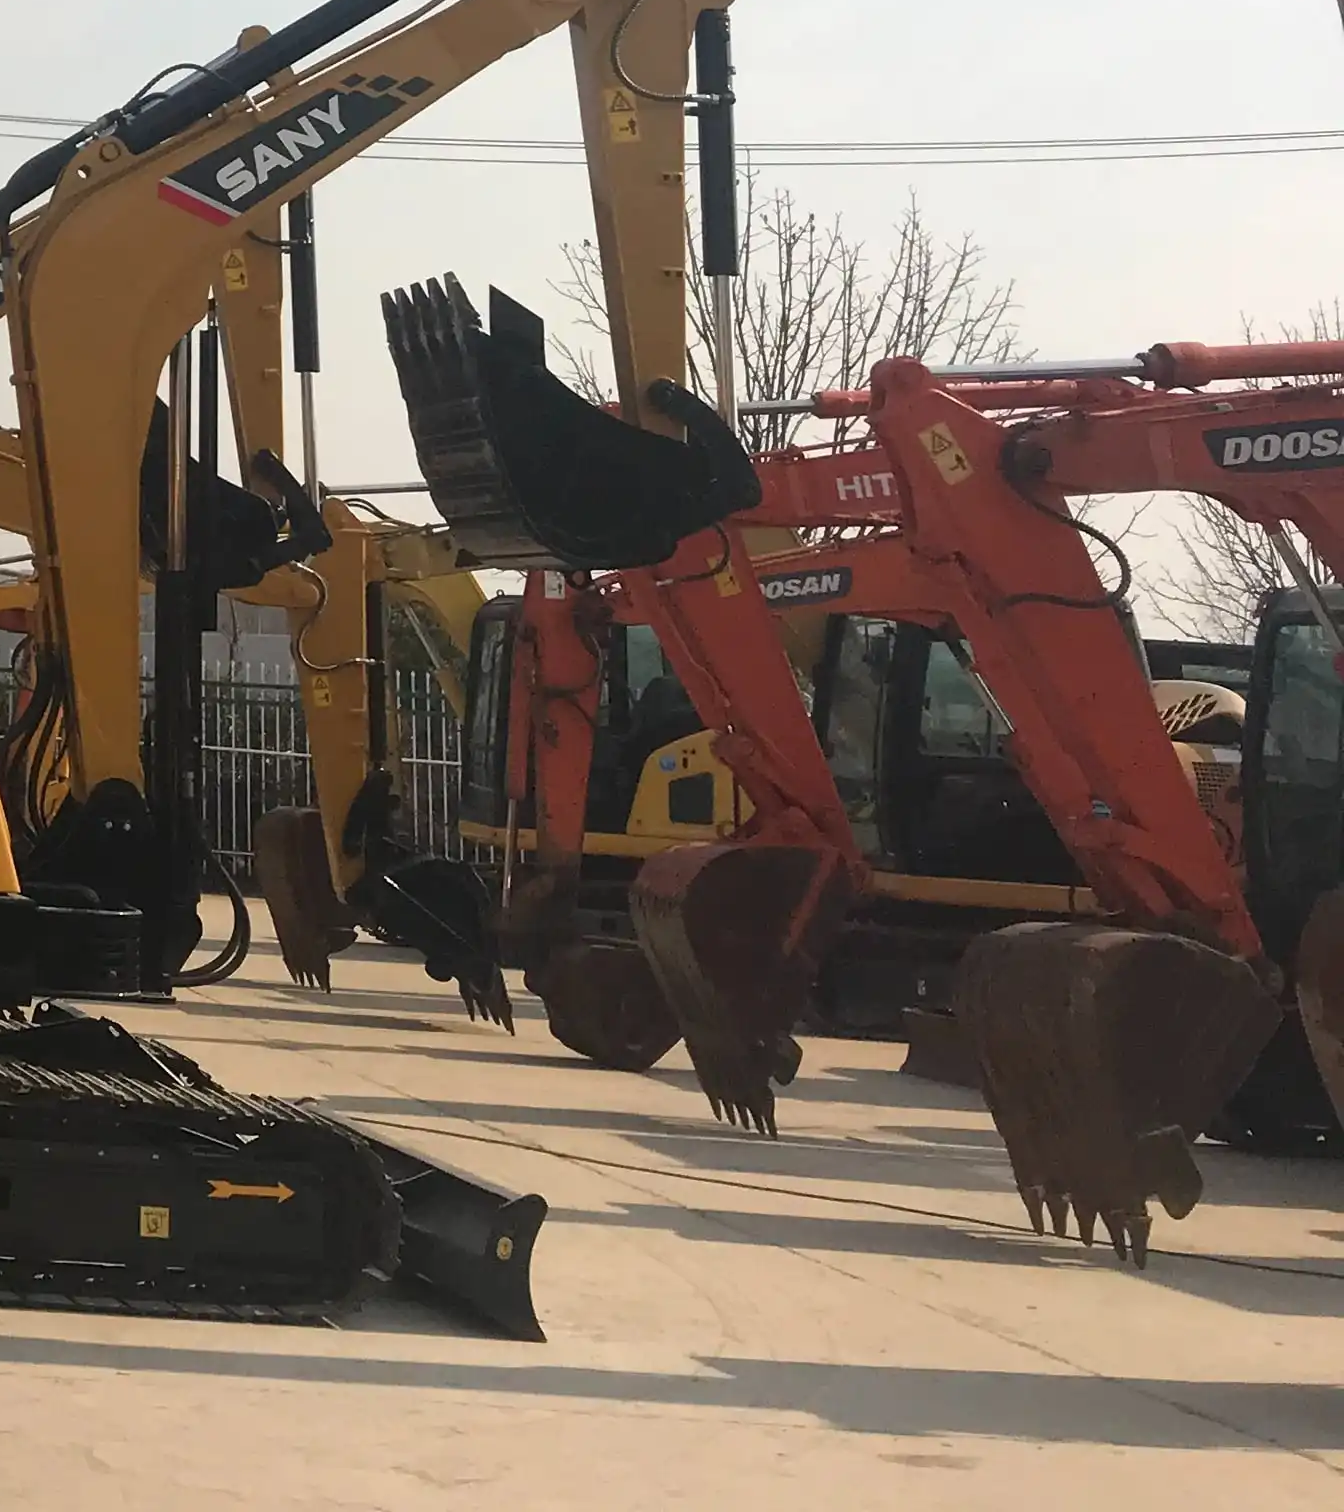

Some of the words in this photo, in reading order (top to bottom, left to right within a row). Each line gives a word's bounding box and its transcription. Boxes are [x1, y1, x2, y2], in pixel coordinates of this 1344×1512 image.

[216, 95, 346, 202] SANY
[1223, 429, 1344, 465] DOOS
[836, 472, 899, 500] HIT
[759, 574, 840, 599] OSAN
